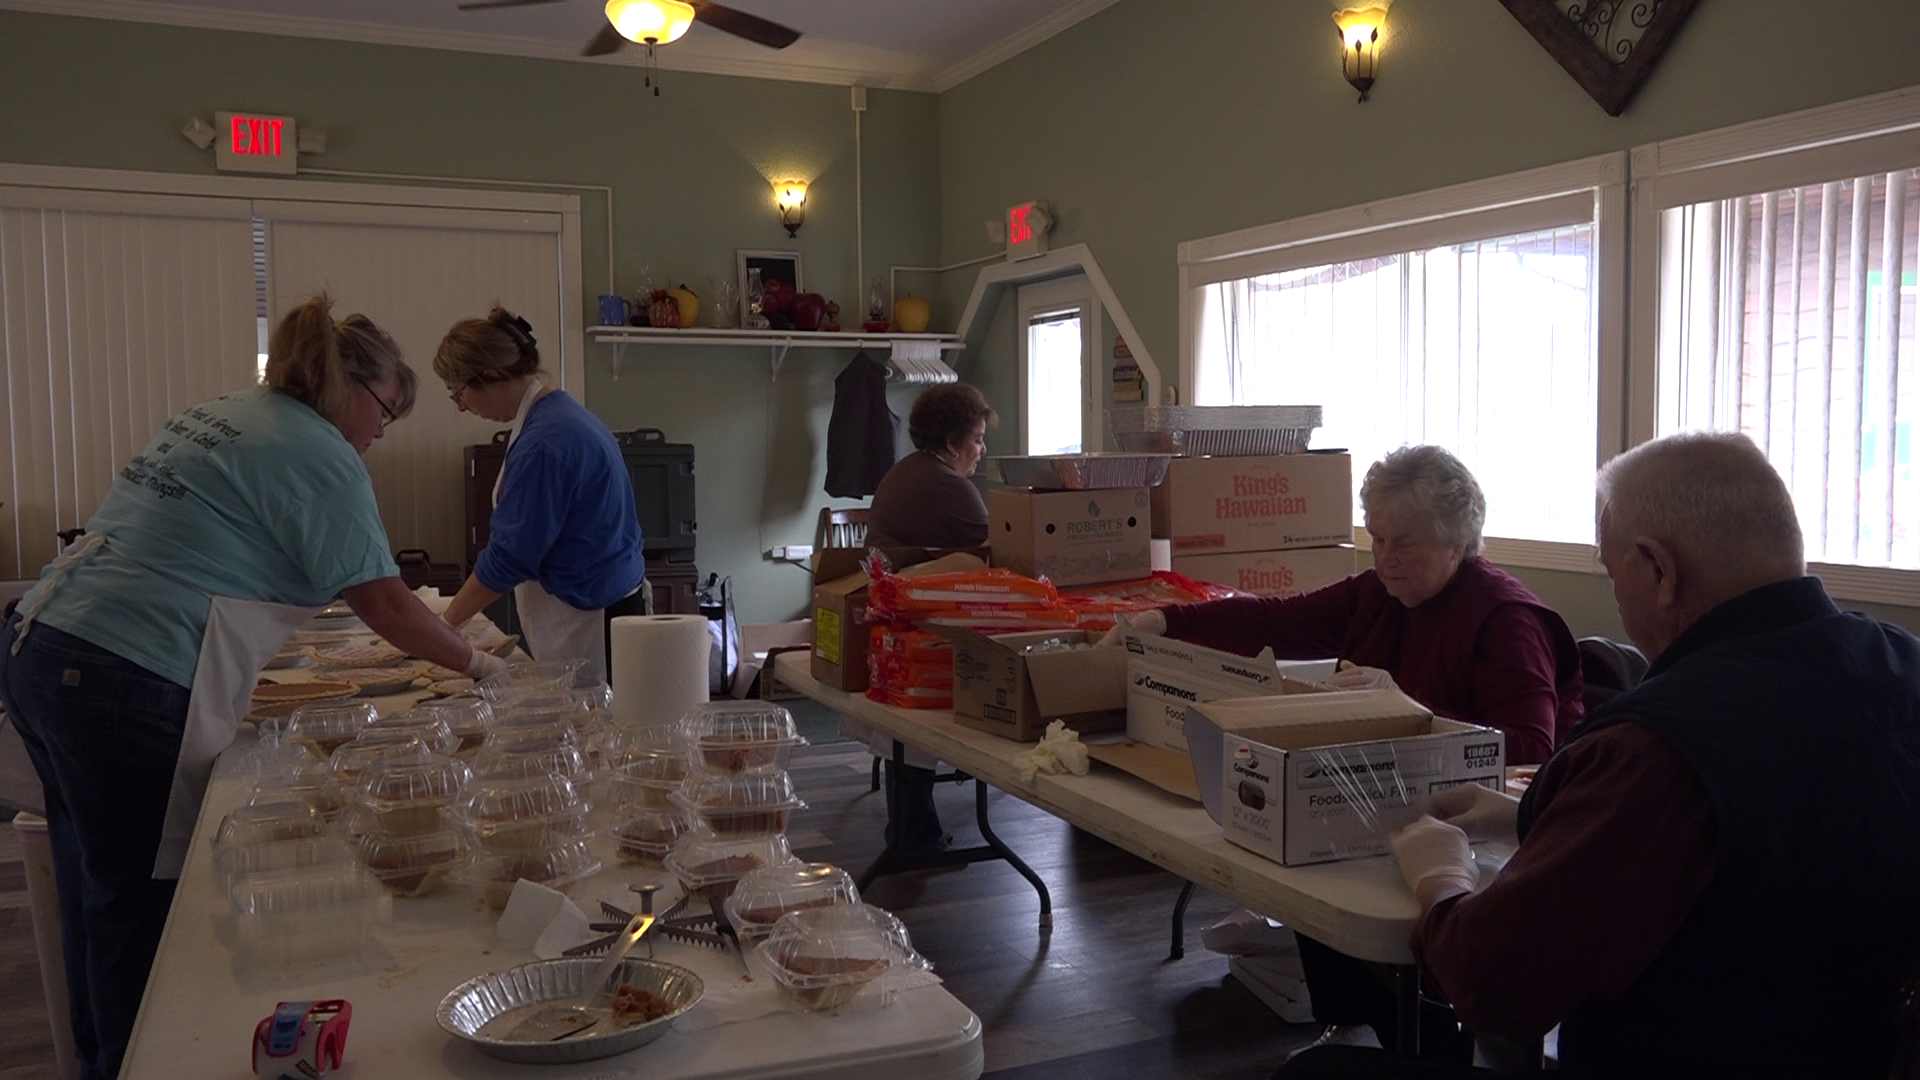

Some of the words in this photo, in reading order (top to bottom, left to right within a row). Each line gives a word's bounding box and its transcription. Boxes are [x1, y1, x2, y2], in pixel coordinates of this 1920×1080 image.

[231, 116, 283, 157] EXIT
[1010, 204, 1032, 244] EXI
[1233, 473, 1290, 496] King's
[1216, 497, 1308, 520] Hawaiian
[1067, 518, 1123, 533] ROBERT'S
[1238, 566, 1294, 591] King's
[1145, 675, 1197, 702] Companions
[1466, 758, 1497, 769] 01245
